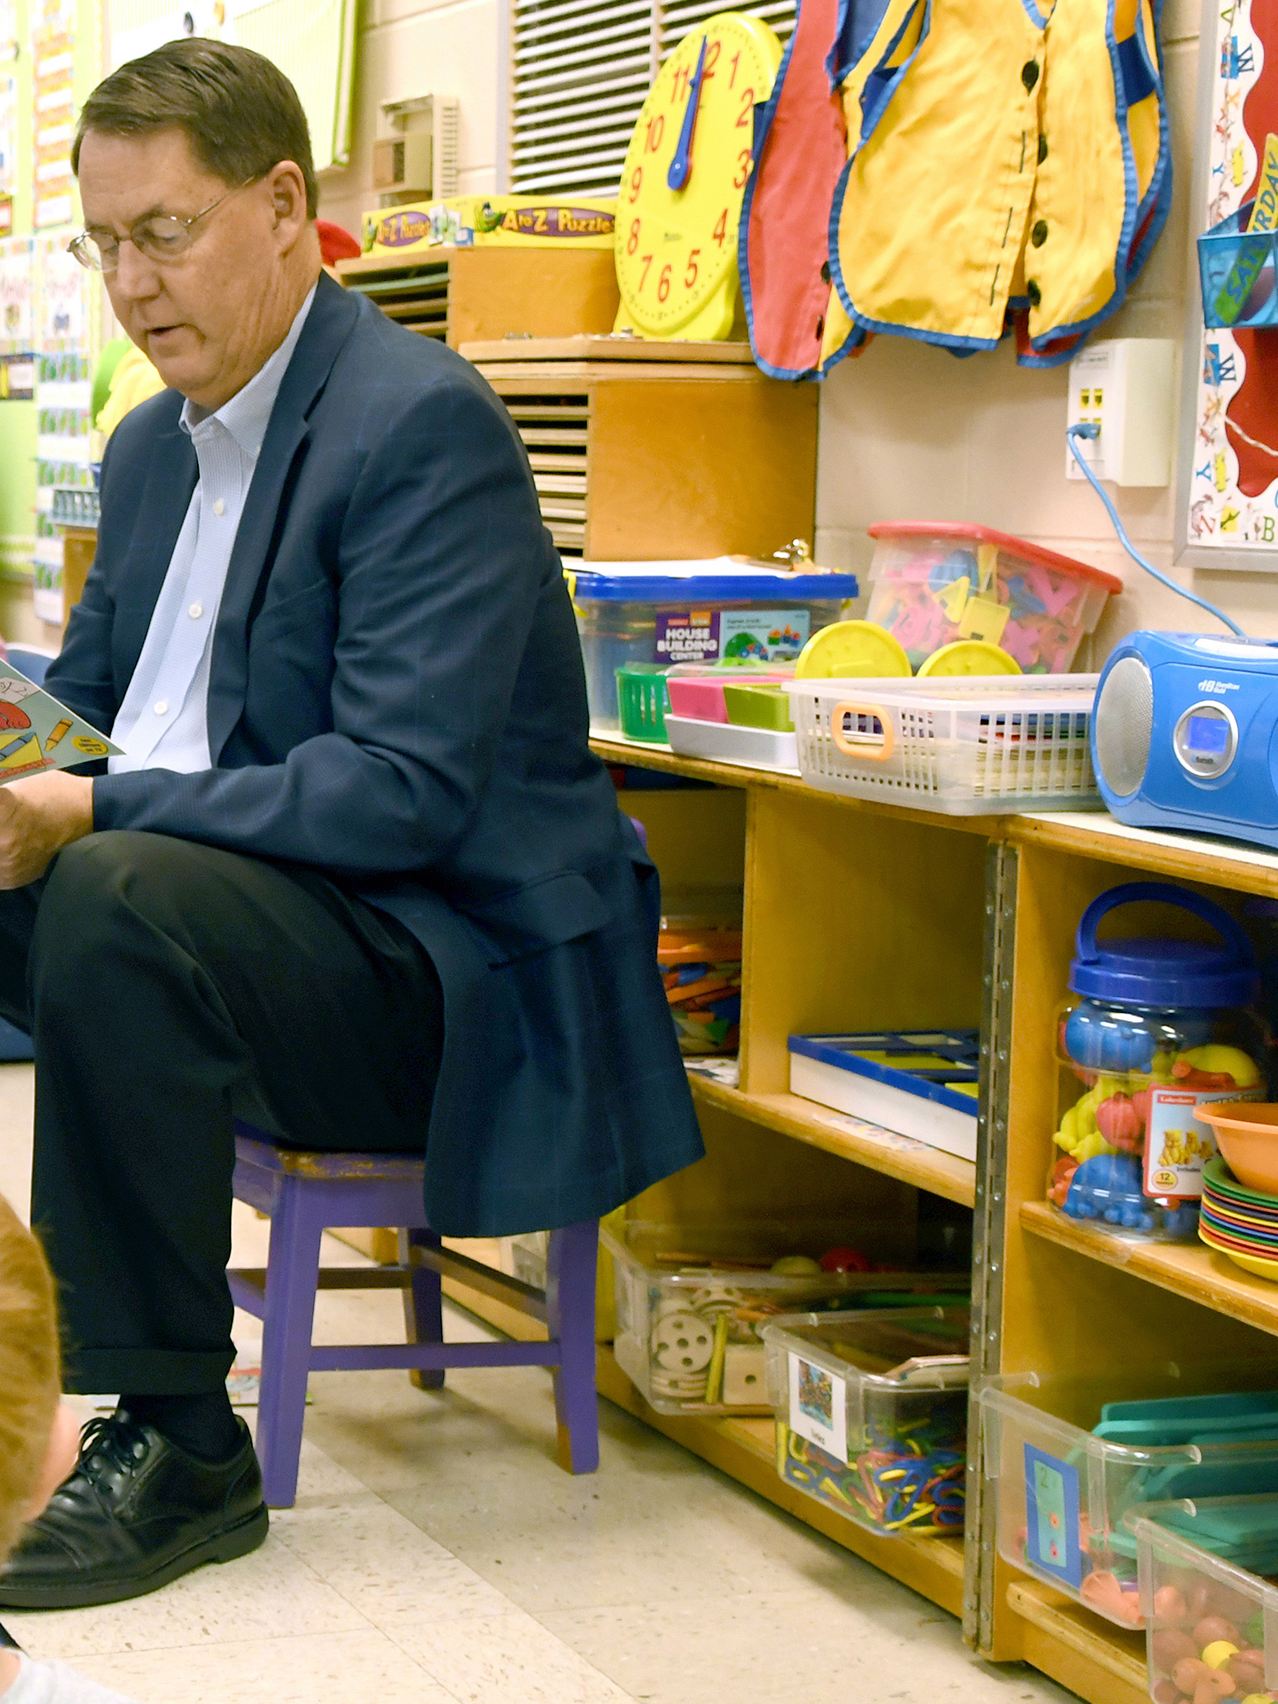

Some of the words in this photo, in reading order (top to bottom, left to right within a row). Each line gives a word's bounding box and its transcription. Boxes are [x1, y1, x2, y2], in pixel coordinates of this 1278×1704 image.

[670, 63, 691, 104] 11
[730, 50, 742, 90] 1
[734, 87, 755, 129] 2
[644, 114, 665, 155] 10
[629, 166, 643, 204] 9
[733, 148, 752, 190] 3
[627, 217, 641, 256] 8
[712, 207, 729, 249] 4
[638, 254, 654, 293] 7
[657, 263, 672, 304] 6
[684, 248, 701, 289] 5
[1195, 460, 1213, 482] Y
[1261, 515, 1276, 543] B
[656, 639, 718, 653] BUILDING
[665, 627, 711, 641] HOUSE
[1160, 1172, 1171, 1181] 12
[1037, 1465, 1049, 1488] 2
